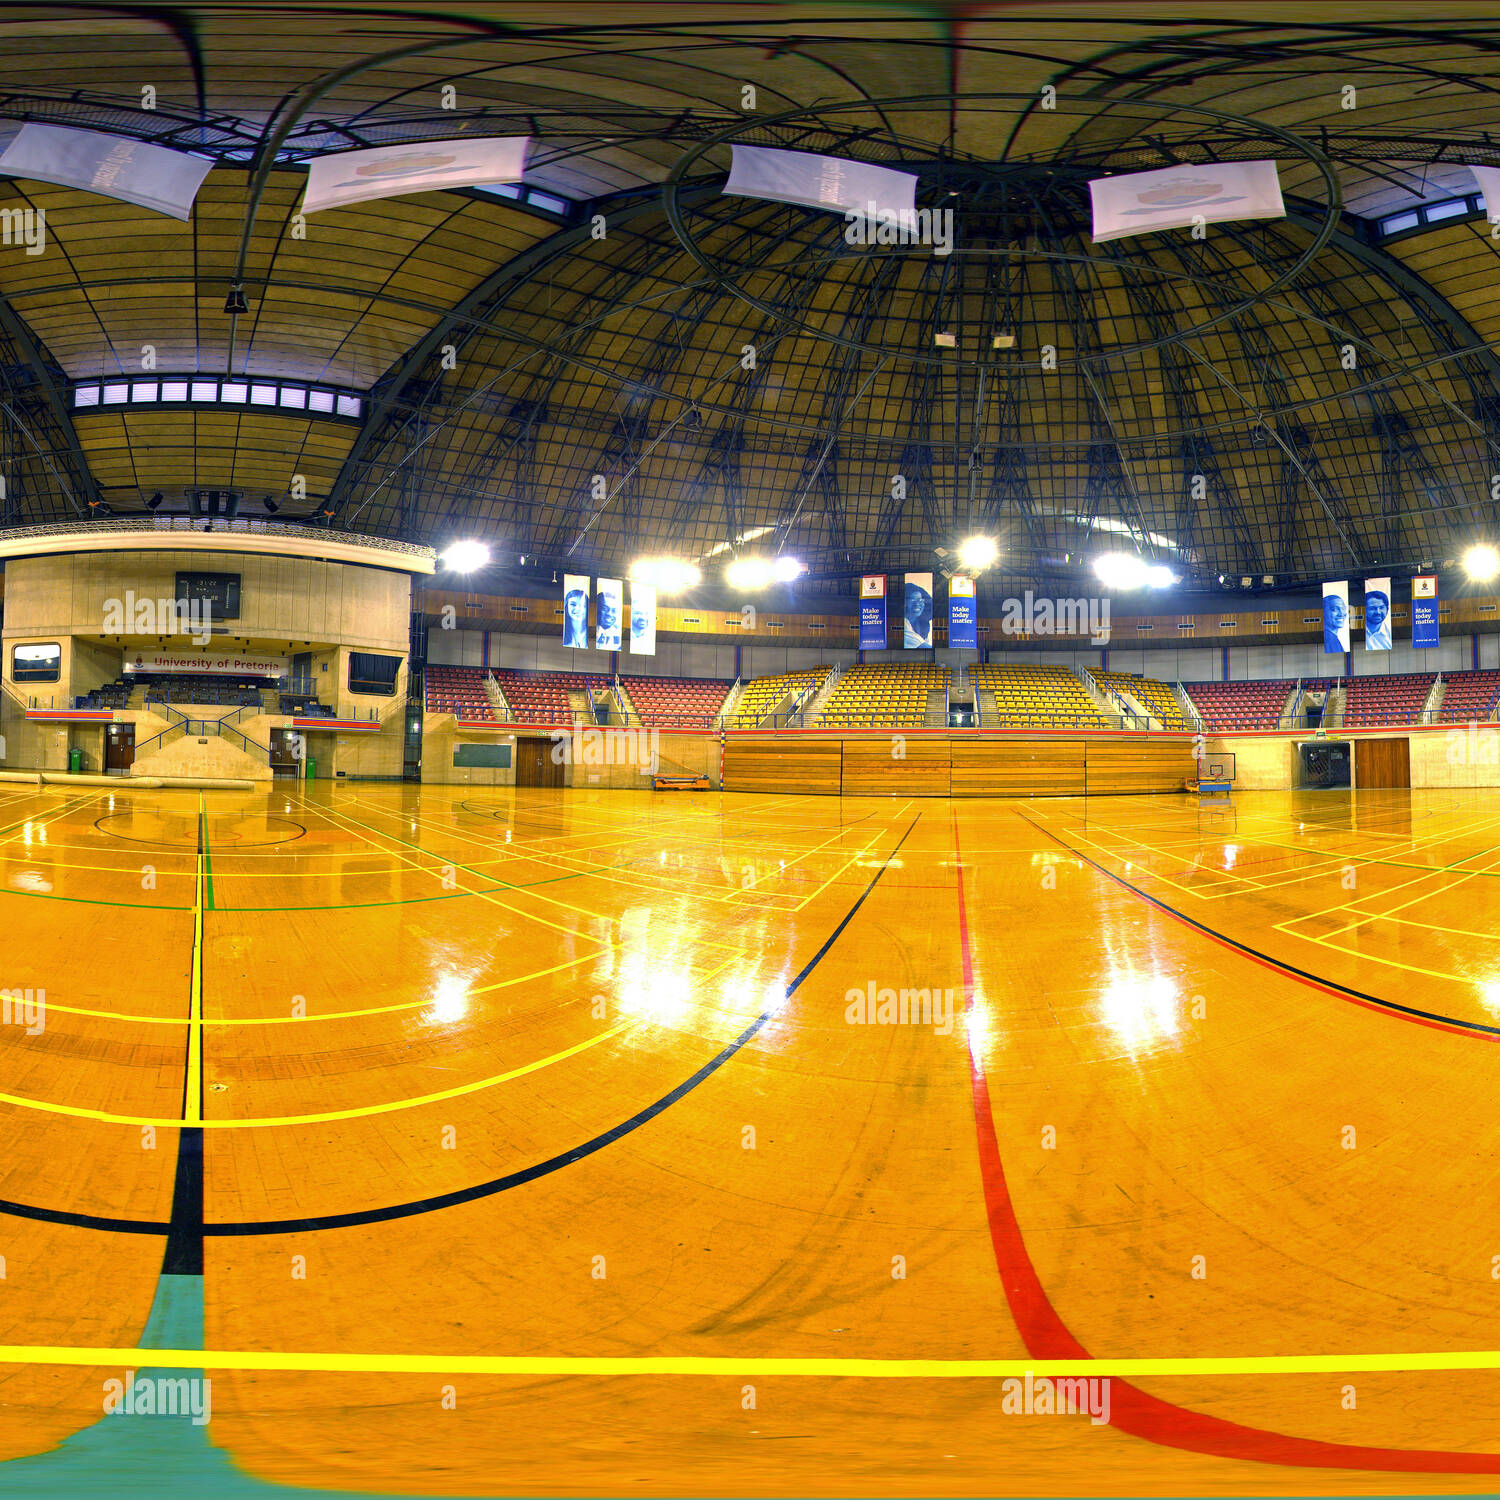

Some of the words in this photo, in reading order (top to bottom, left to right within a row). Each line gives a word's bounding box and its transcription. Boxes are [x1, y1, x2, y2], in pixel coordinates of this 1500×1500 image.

[154, 657, 212, 669] University
[217, 659, 229, 669] of
[234, 660, 279, 671] Pretoria
